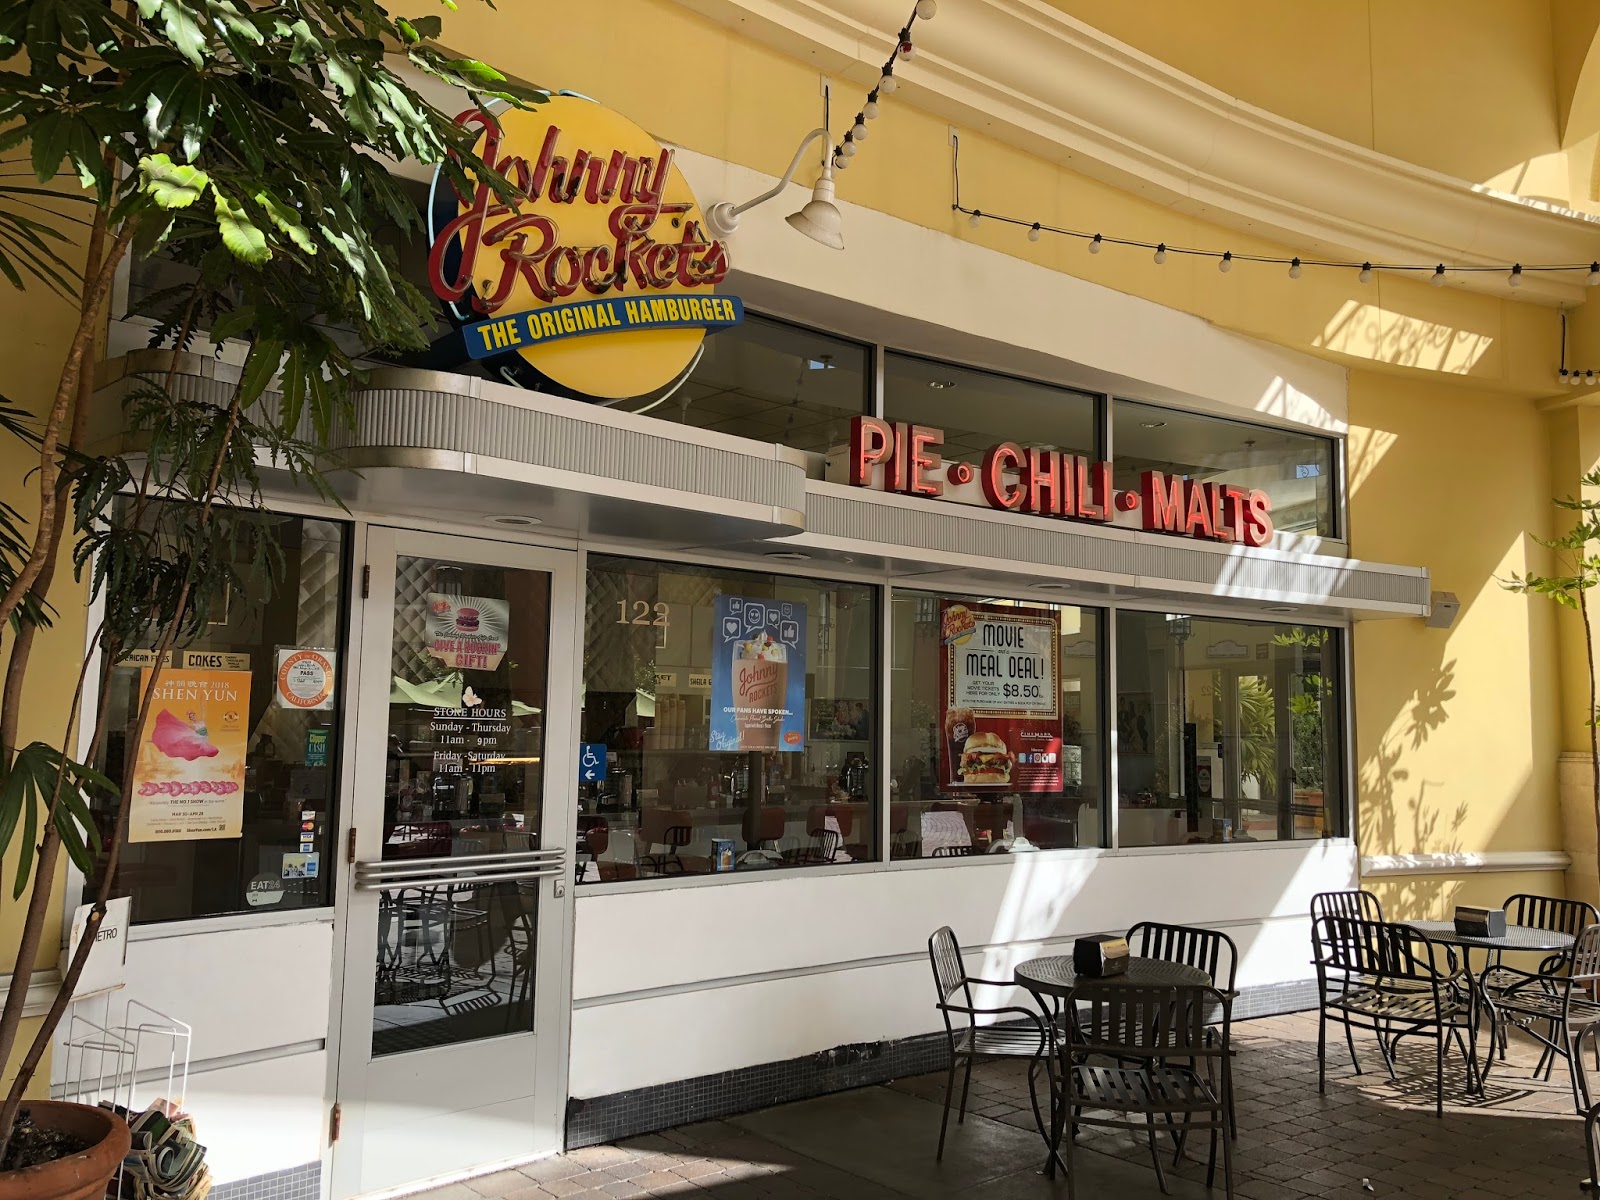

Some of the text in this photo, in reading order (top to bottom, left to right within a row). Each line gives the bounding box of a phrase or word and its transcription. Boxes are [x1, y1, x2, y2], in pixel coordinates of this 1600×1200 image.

[428, 108, 676, 302] Johnny
[472, 213, 732, 314] Rockets
[477, 298, 736, 351] THE ORIGINAL HAMBURGER
[849, 415, 1275, 548] PIE CHILI MALTS
[616, 599, 671, 627] 122
[983, 624, 1024, 648] MOVIE
[434, 640, 454, 652] GIVE
[188, 654, 223, 668] COKES
[280, 654, 302, 680] COUNTY
[312, 654, 332, 679] ORANGE
[456, 653, 488, 668] GIFT!
[966, 653, 1044, 680] MEAL DEAL!
[739, 662, 778, 696] Johnny
[152, 688, 238, 702] SHEN YUN
[286, 692, 326, 704] CALIFORNIA
[749, 682, 778, 704] ROCKETS
[434, 707, 506, 718] STORE HOURS
[430, 722, 464, 734] Sunday
[472, 722, 512, 734] Thursday
[441, 736, 464, 744] 11am
[434, 750, 462, 762] Friday
[440, 764, 463, 773] 11am
[472, 764, 496, 774] 11pm
[250, 880, 281, 890] EAT24
